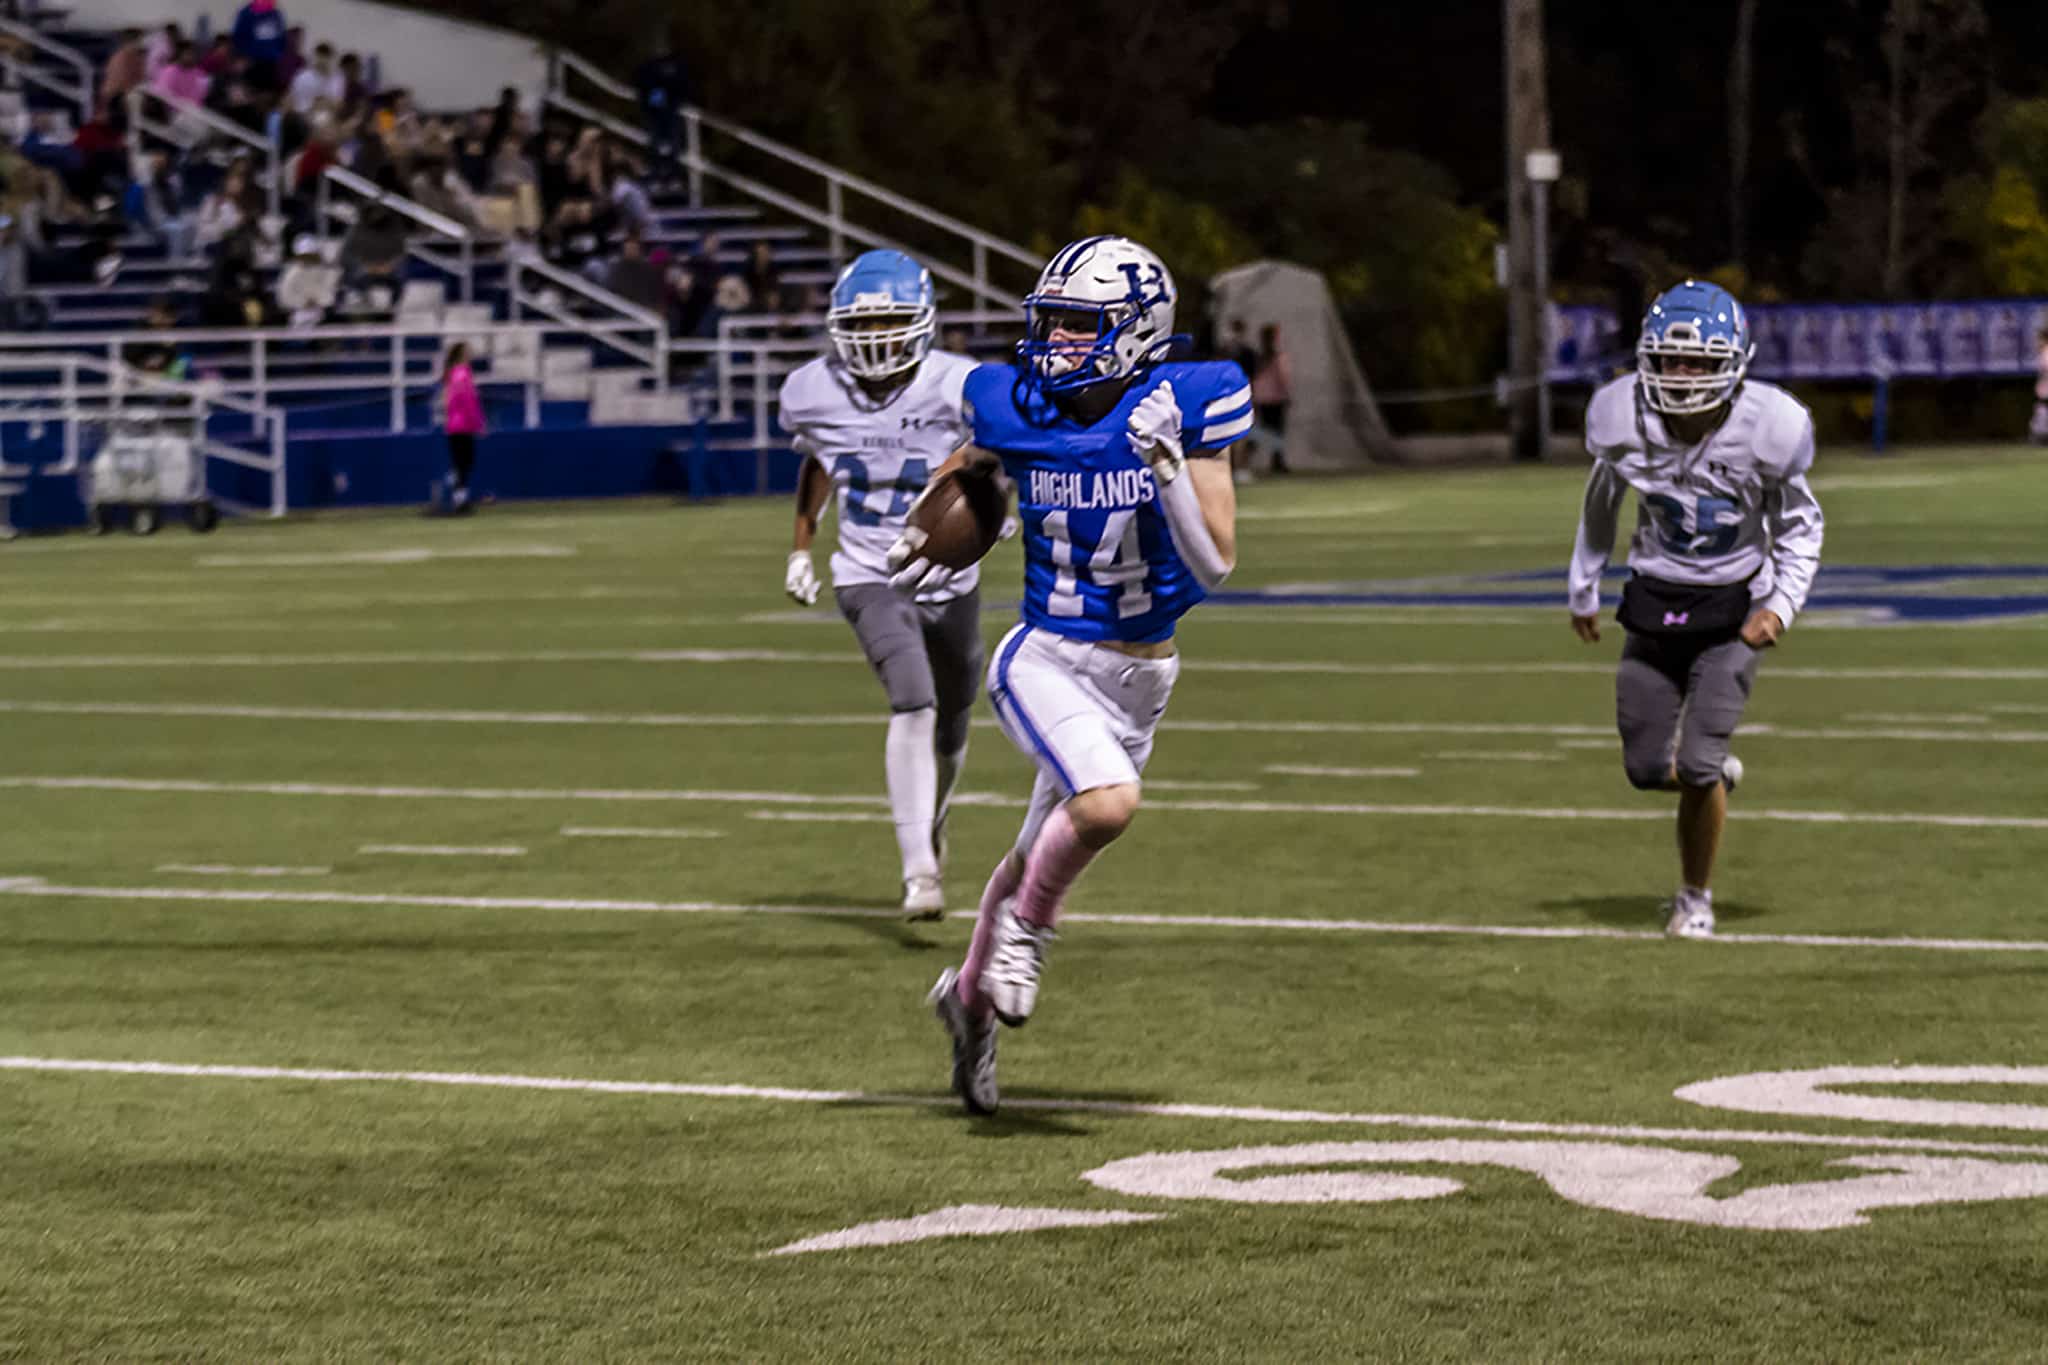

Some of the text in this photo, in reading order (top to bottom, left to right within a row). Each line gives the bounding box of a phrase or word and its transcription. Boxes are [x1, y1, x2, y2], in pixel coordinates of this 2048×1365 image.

[1117, 263, 1171, 309] H
[1030, 467, 1155, 509] HIGHLANDS
[1041, 509, 1153, 619] 14
